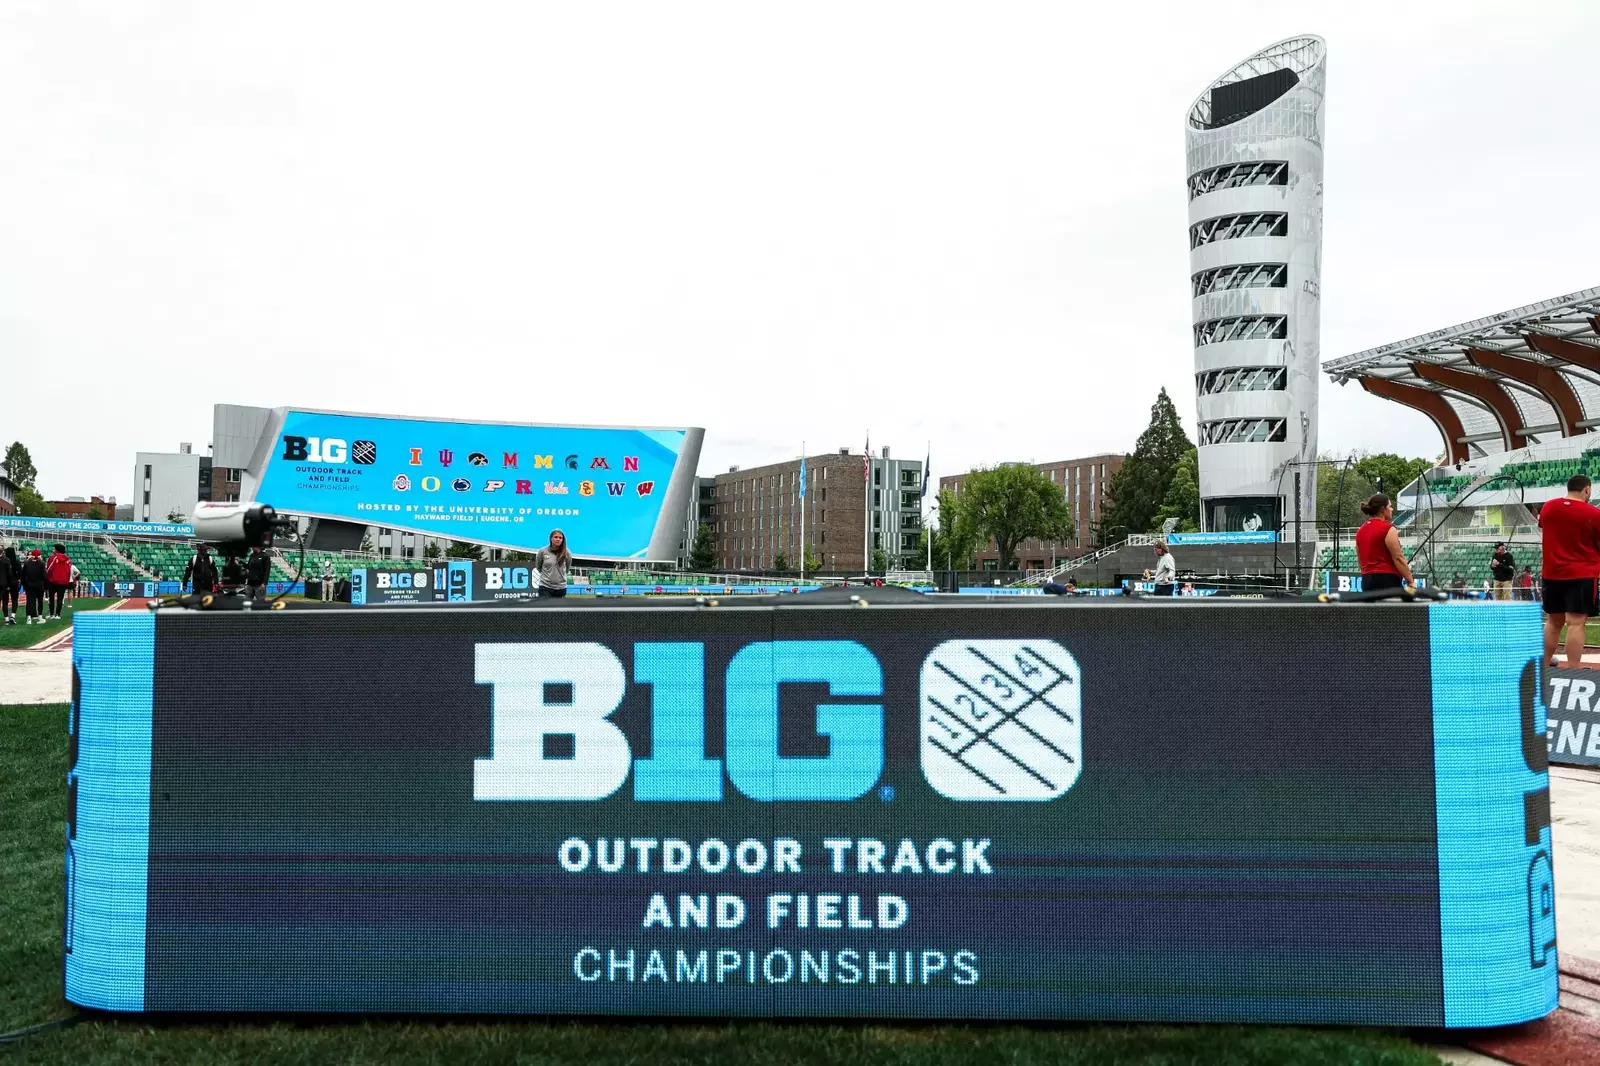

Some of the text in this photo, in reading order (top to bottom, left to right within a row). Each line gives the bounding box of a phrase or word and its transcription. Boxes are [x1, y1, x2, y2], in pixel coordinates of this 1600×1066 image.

[295, 466, 334, 474] OUTDOOR
[503, 452, 518, 469] M
[534, 455, 553, 469] M
[624, 456, 639, 472] N
[297, 482, 360, 492] CHAMPIONSHIPS
[483, 480, 505, 493] P
[516, 479, 532, 495] R
[607, 482, 626, 496] W
[357, 503, 401, 511] HOSTED
[406, 504, 419, 512] BY
[424, 505, 444, 513] THE
[449, 506, 515, 514] UNIVERSITY
[537, 508, 579, 516] OREGON
[414, 513, 450, 521] HAYWARD
[118, 524, 152, 532] OUTDOOR
[153, 525, 176, 533] TRACK
[955, 694, 989, 722] 2
[981, 674, 1014, 698] 3
[557, 836, 994, 875] OUTDOOR TRACK
[642, 893, 909, 930] AND FIELD
[573, 947, 980, 985] CHAMPIONSHIPS
